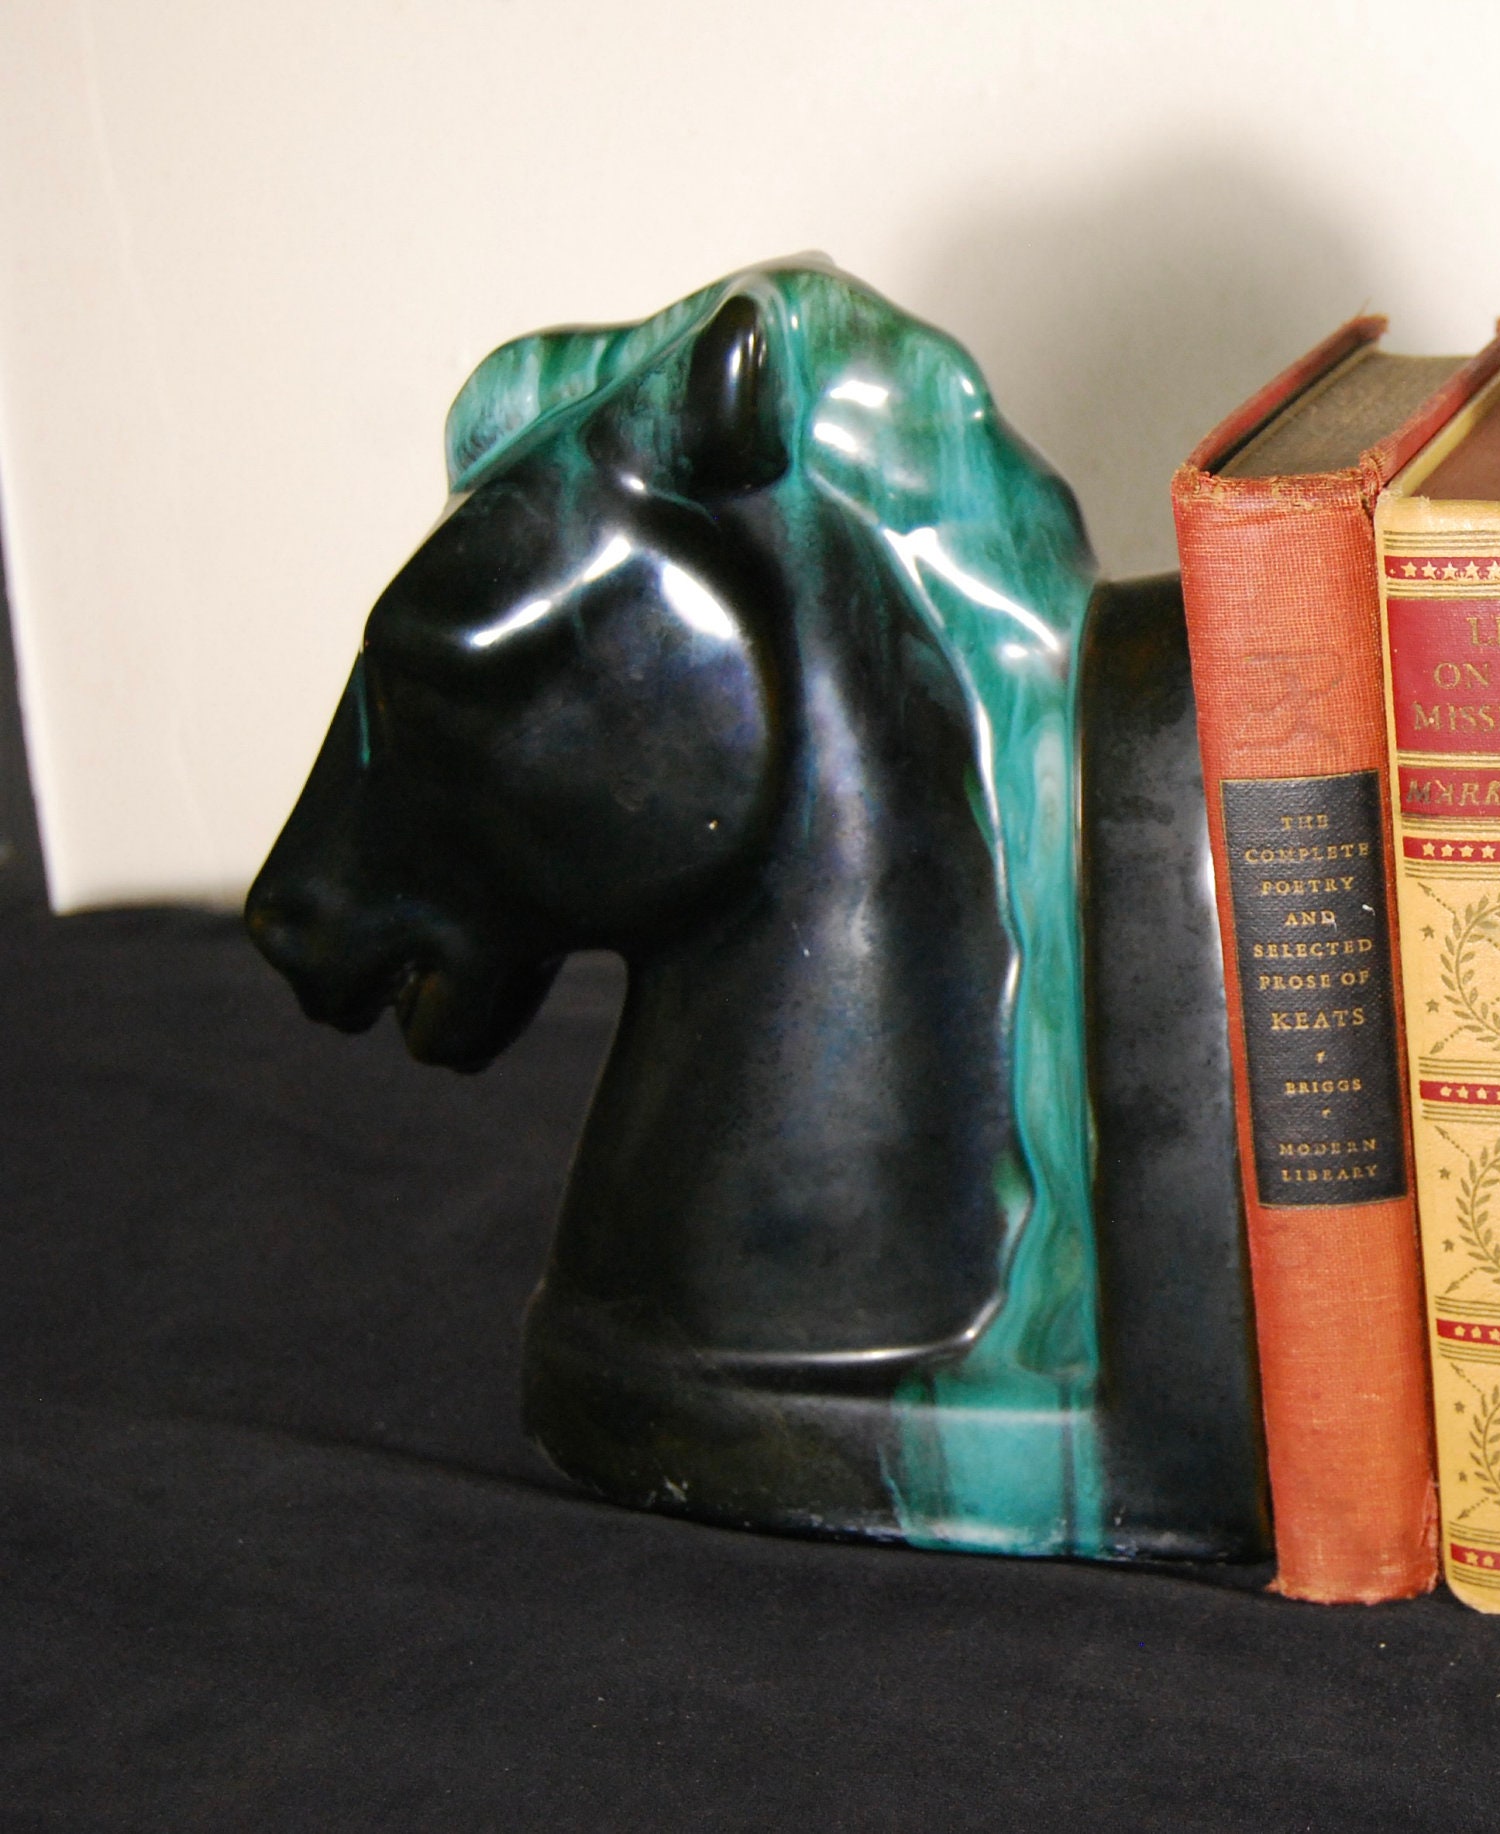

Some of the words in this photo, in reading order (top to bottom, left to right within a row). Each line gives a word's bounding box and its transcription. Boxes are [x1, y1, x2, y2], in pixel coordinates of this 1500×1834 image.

[1433, 661, 1489, 689] ON
[1281, 814, 1329, 830] THE
[1245, 842, 1370, 863] COMPLETE
[1261, 876, 1354, 895] POETRY
[1284, 910, 1336, 926] AND
[1253, 938, 1373, 958] SELECTED
[1259, 974, 1331, 990] PROSE
[1341, 970, 1371, 985] OF
[1271, 1008, 1366, 1030] KEATS
[1284, 1078, 1362, 1095] BRIGGS
[1279, 1138, 1377, 1156] MODERN
[1281, 1164, 1378, 1182] LIBRARY
